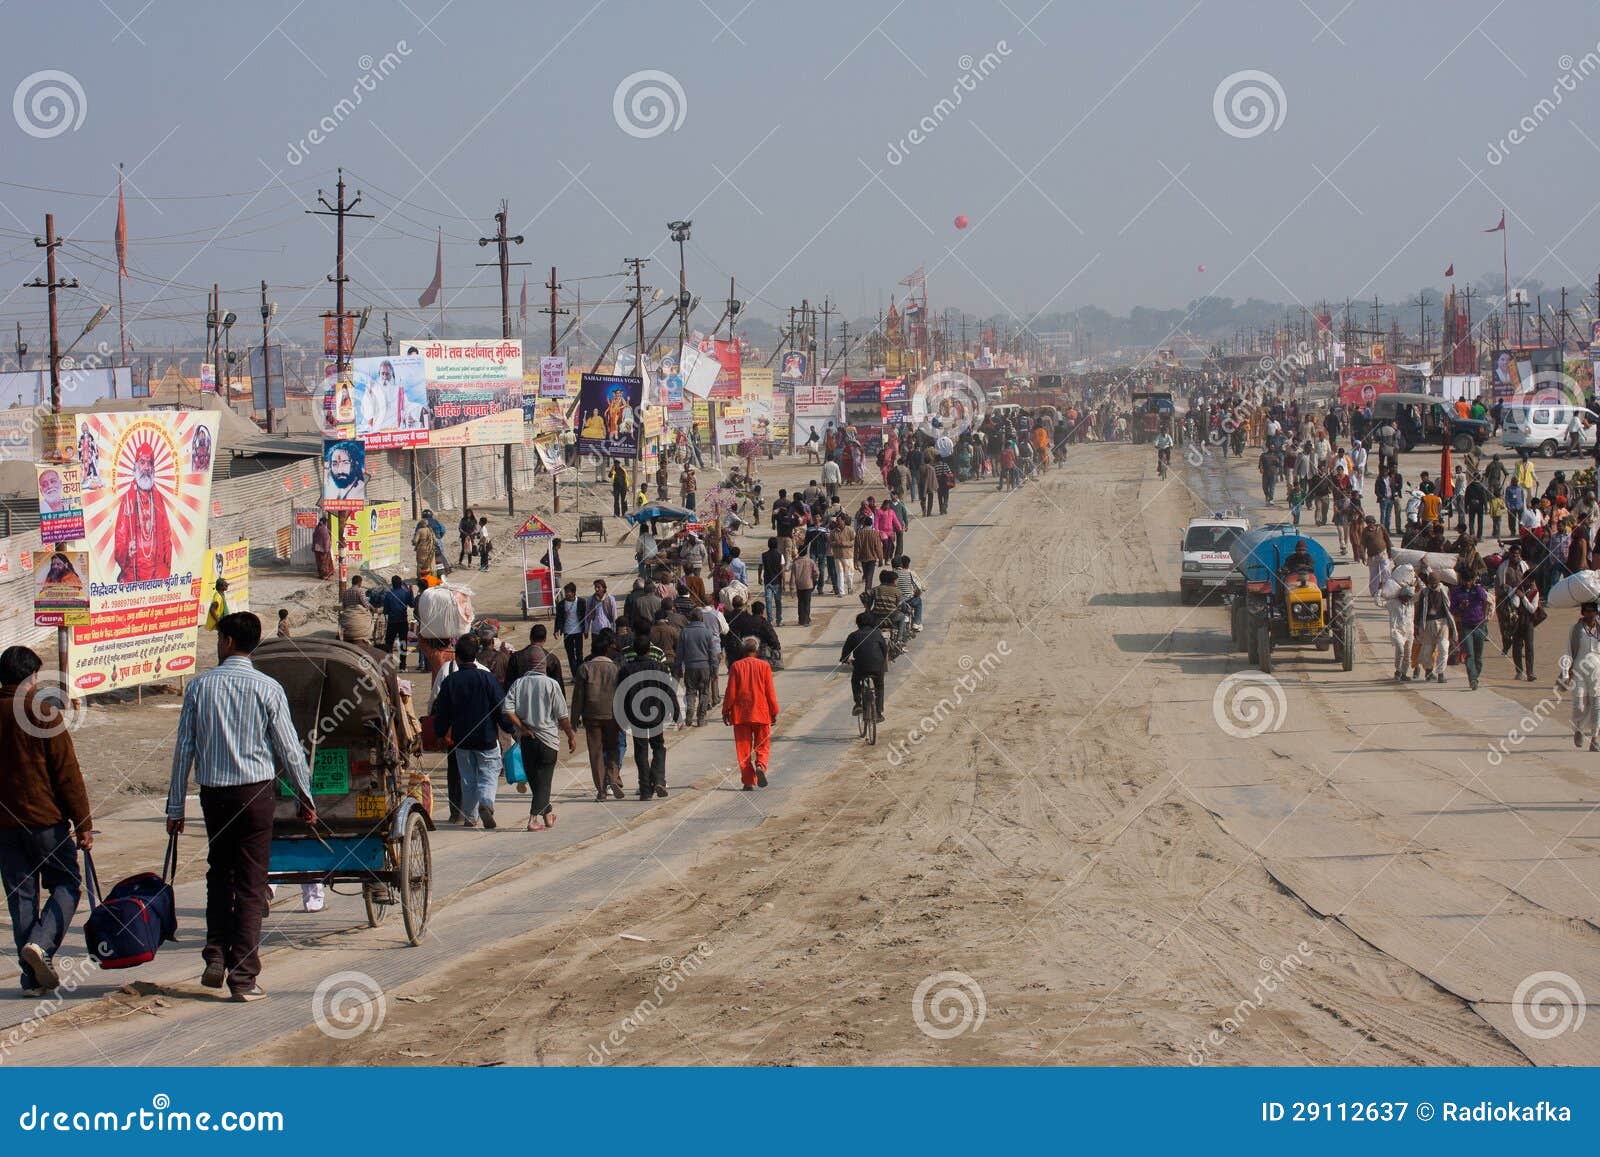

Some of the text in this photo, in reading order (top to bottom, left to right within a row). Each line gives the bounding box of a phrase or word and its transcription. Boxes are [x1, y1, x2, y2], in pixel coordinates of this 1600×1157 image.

[63, 470, 78, 482] राम
[62, 482, 80, 494] कथा
[321, 755, 344, 765] 2013
